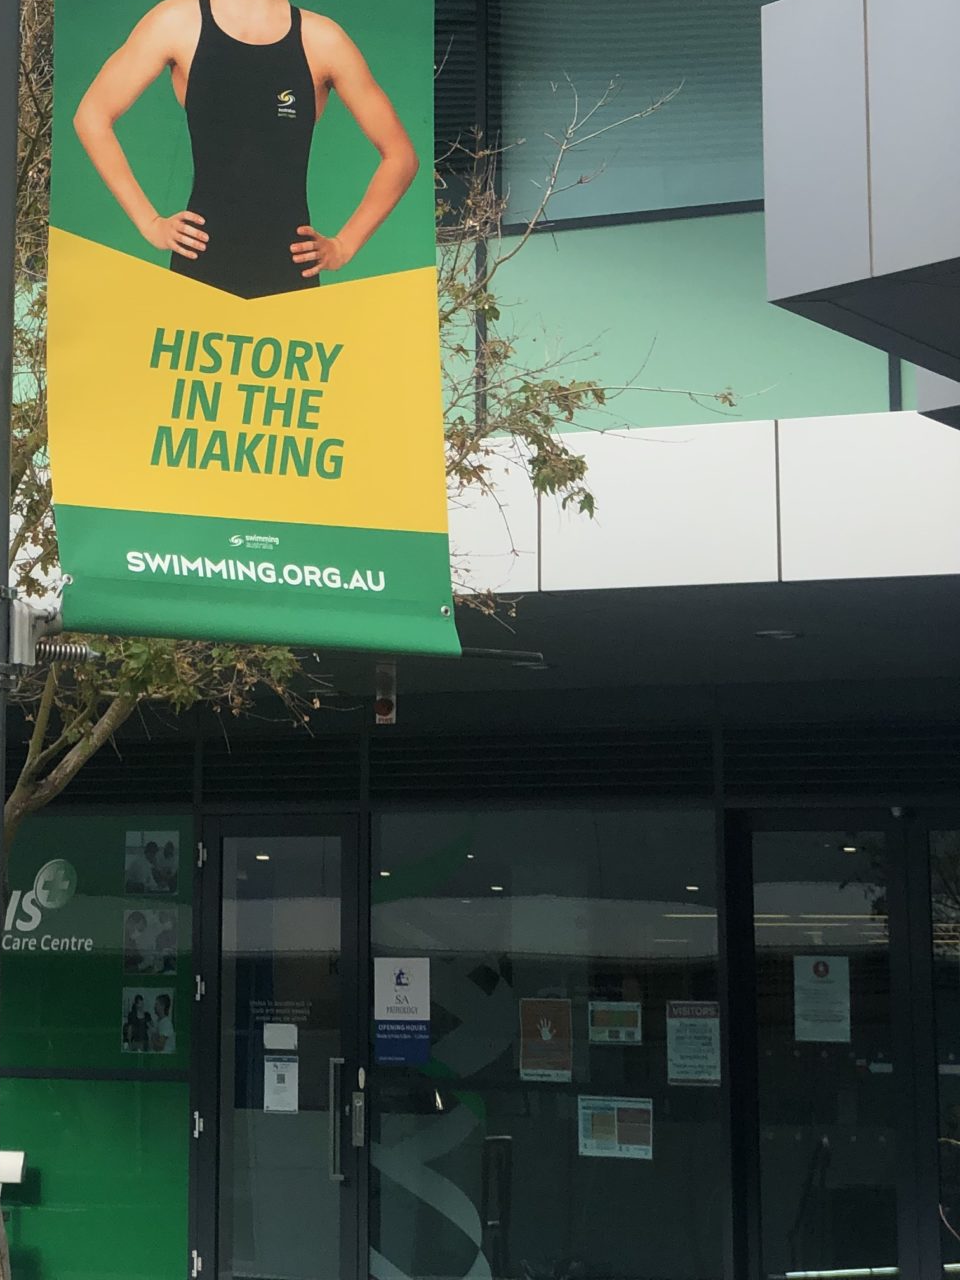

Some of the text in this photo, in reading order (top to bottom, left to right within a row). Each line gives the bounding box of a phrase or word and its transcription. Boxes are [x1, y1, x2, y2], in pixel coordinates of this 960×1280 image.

[149, 327, 344, 383] HISTORY
[171, 378, 324, 430] IN THE
[150, 425, 345, 480] MAKING
[126, 551, 385, 591] SWIMMING.ORG.AU
[1, 934, 93, 951] Care Centre
